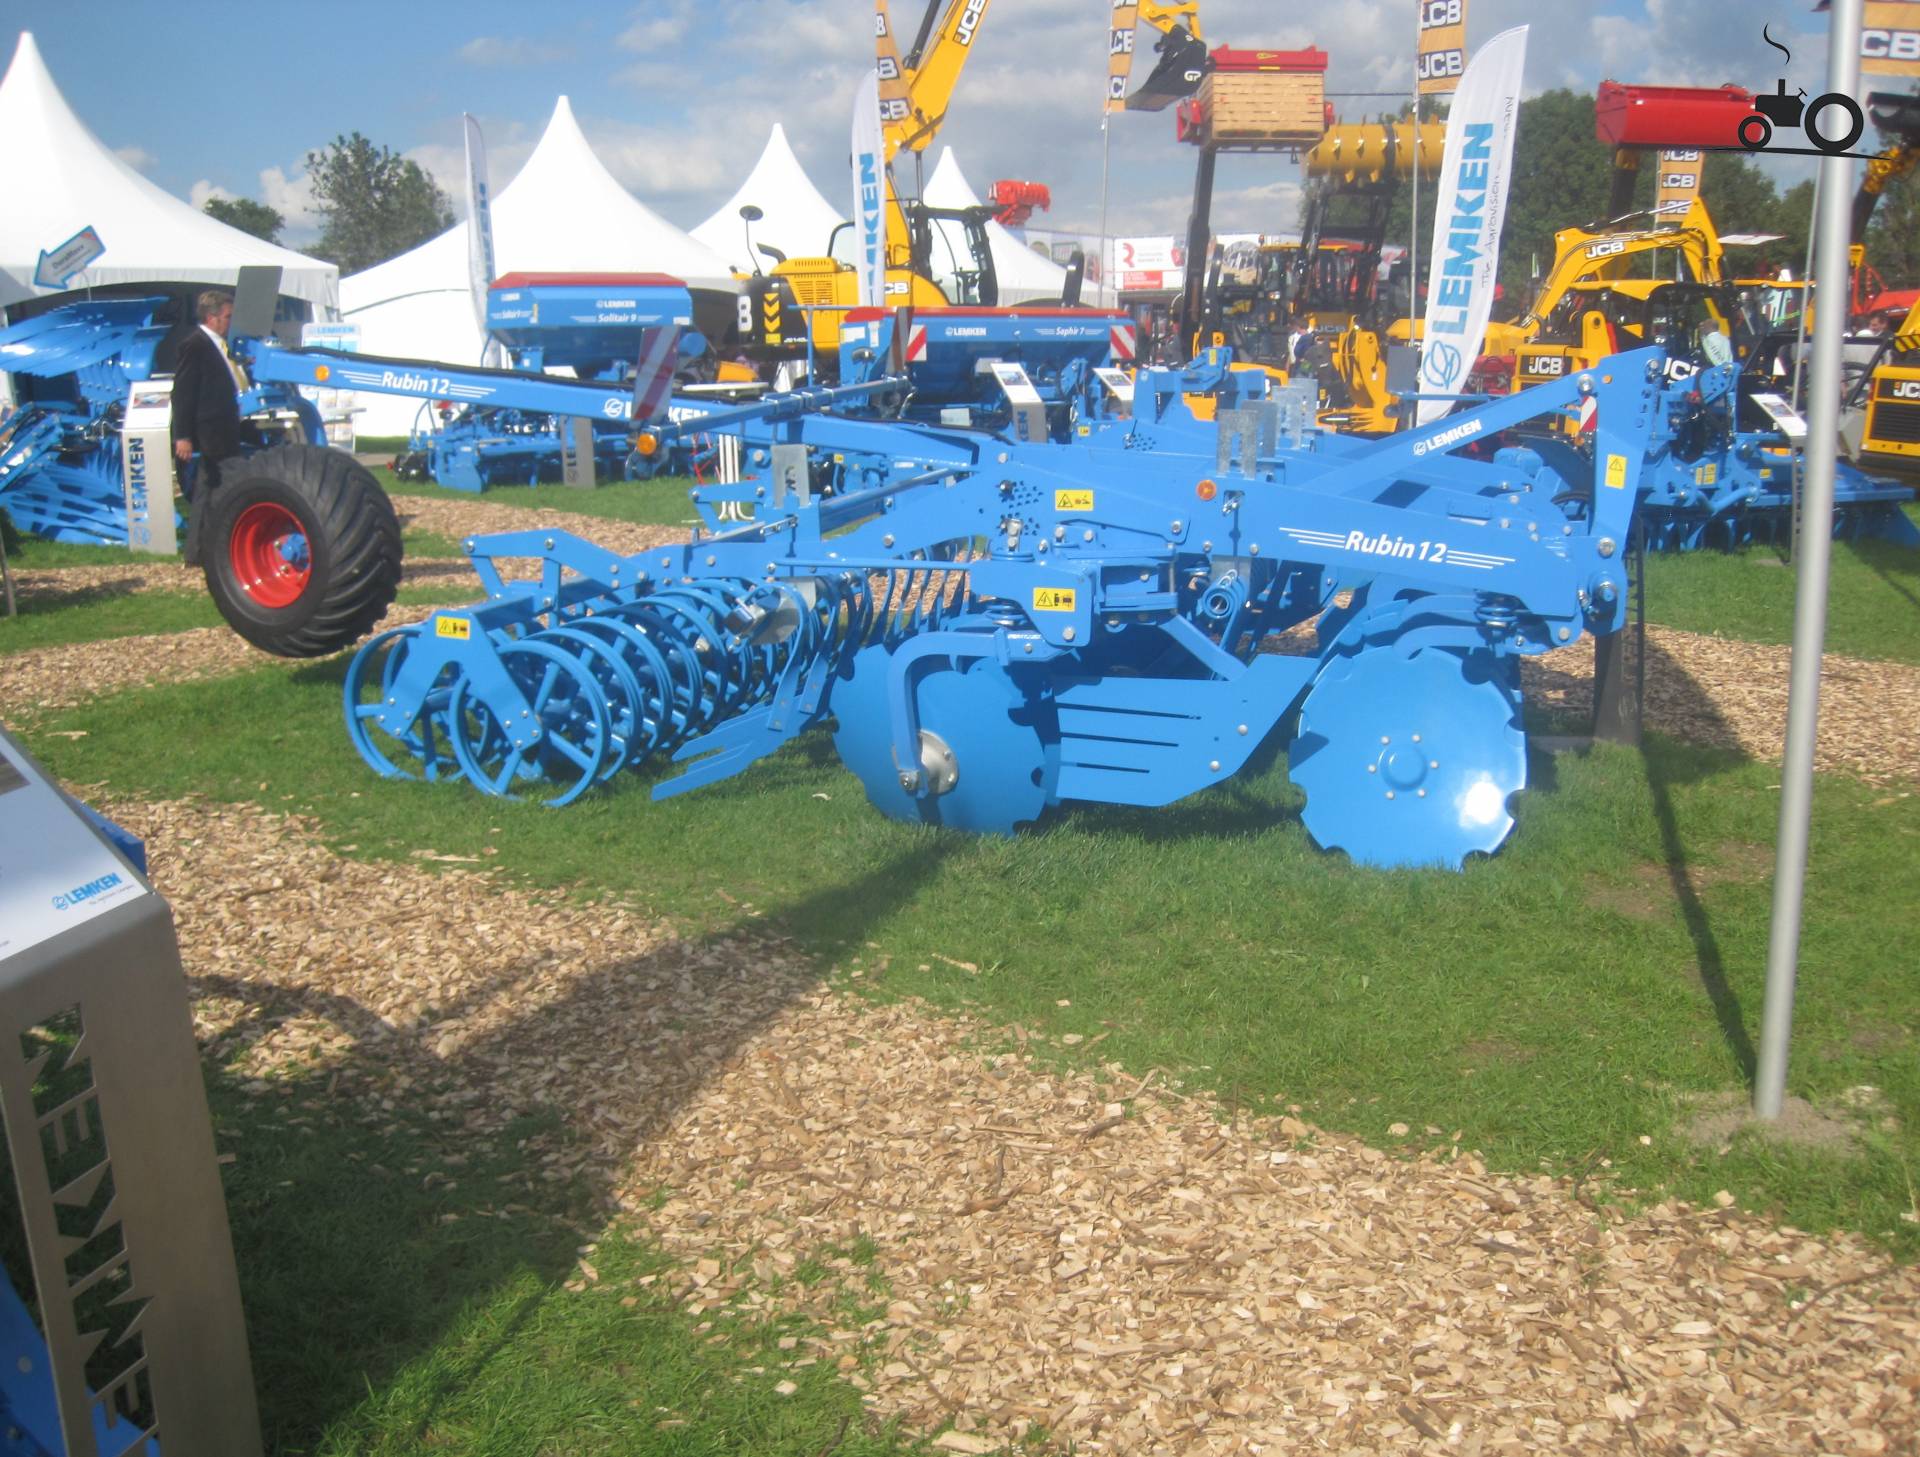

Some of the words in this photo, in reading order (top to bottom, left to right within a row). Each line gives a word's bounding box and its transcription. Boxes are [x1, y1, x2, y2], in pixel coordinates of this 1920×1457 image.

[1860, 30, 1920, 59] CB
[1431, 122, 1494, 335] LEMKEN
[1586, 241, 1625, 258] JCB
[885, 283, 908, 294] CB
[603, 300, 636, 308] LEMKEN
[598, 313, 628, 323] Solitair
[630, 312, 637, 322] 9
[953, 328, 987, 336] LEMKEN
[1056, 327, 1078, 337] Saphir
[1080, 327, 1085, 335] 7
[1529, 357, 1562, 374] JCB
[382, 371, 428, 393] Rubin
[431, 377, 449, 395] 12
[1894, 382, 1920, 398] JC
[1427, 419, 1482, 450] LEMKEN
[128, 438, 149, 522] LEMKEN
[1344, 530, 1416, 558] Rubin
[1419, 541, 1448, 564] 12
[64, 872, 122, 905] LEMKEN
